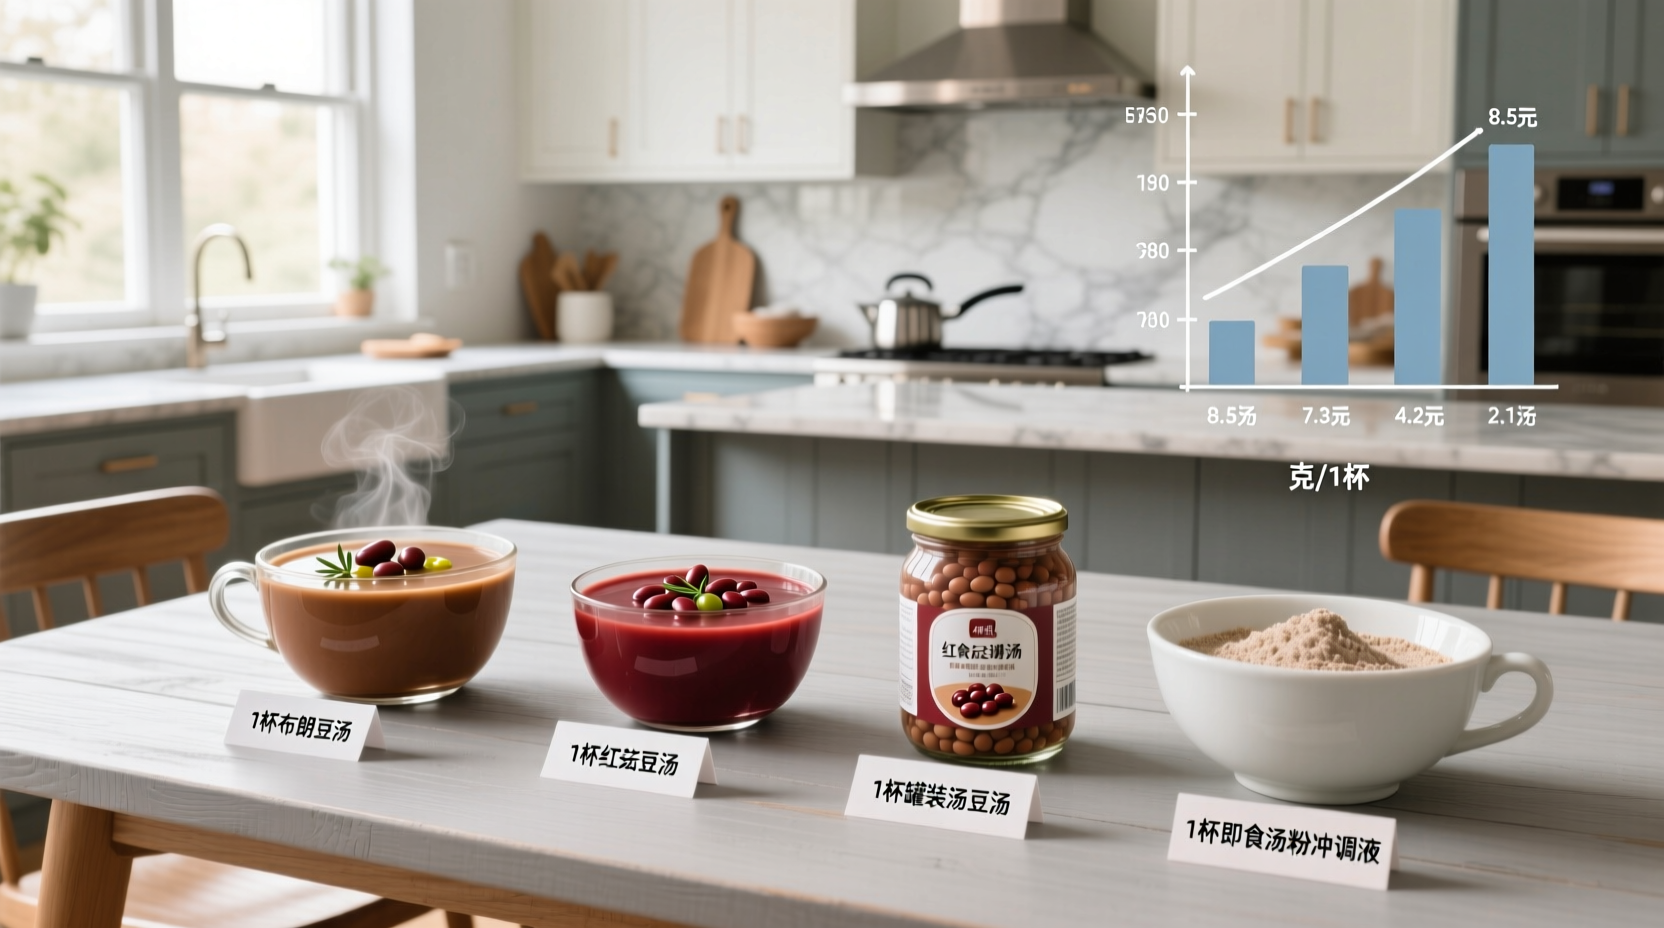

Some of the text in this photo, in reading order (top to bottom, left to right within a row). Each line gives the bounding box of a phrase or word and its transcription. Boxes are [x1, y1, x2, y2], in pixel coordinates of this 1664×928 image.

[251, 709, 353, 743] 1杯布朗豆汤
[873, 778, 1011, 816] 1杯罐装汤豆汤
[1186, 818, 1382, 865] 1杯即食汤粉冲调液
